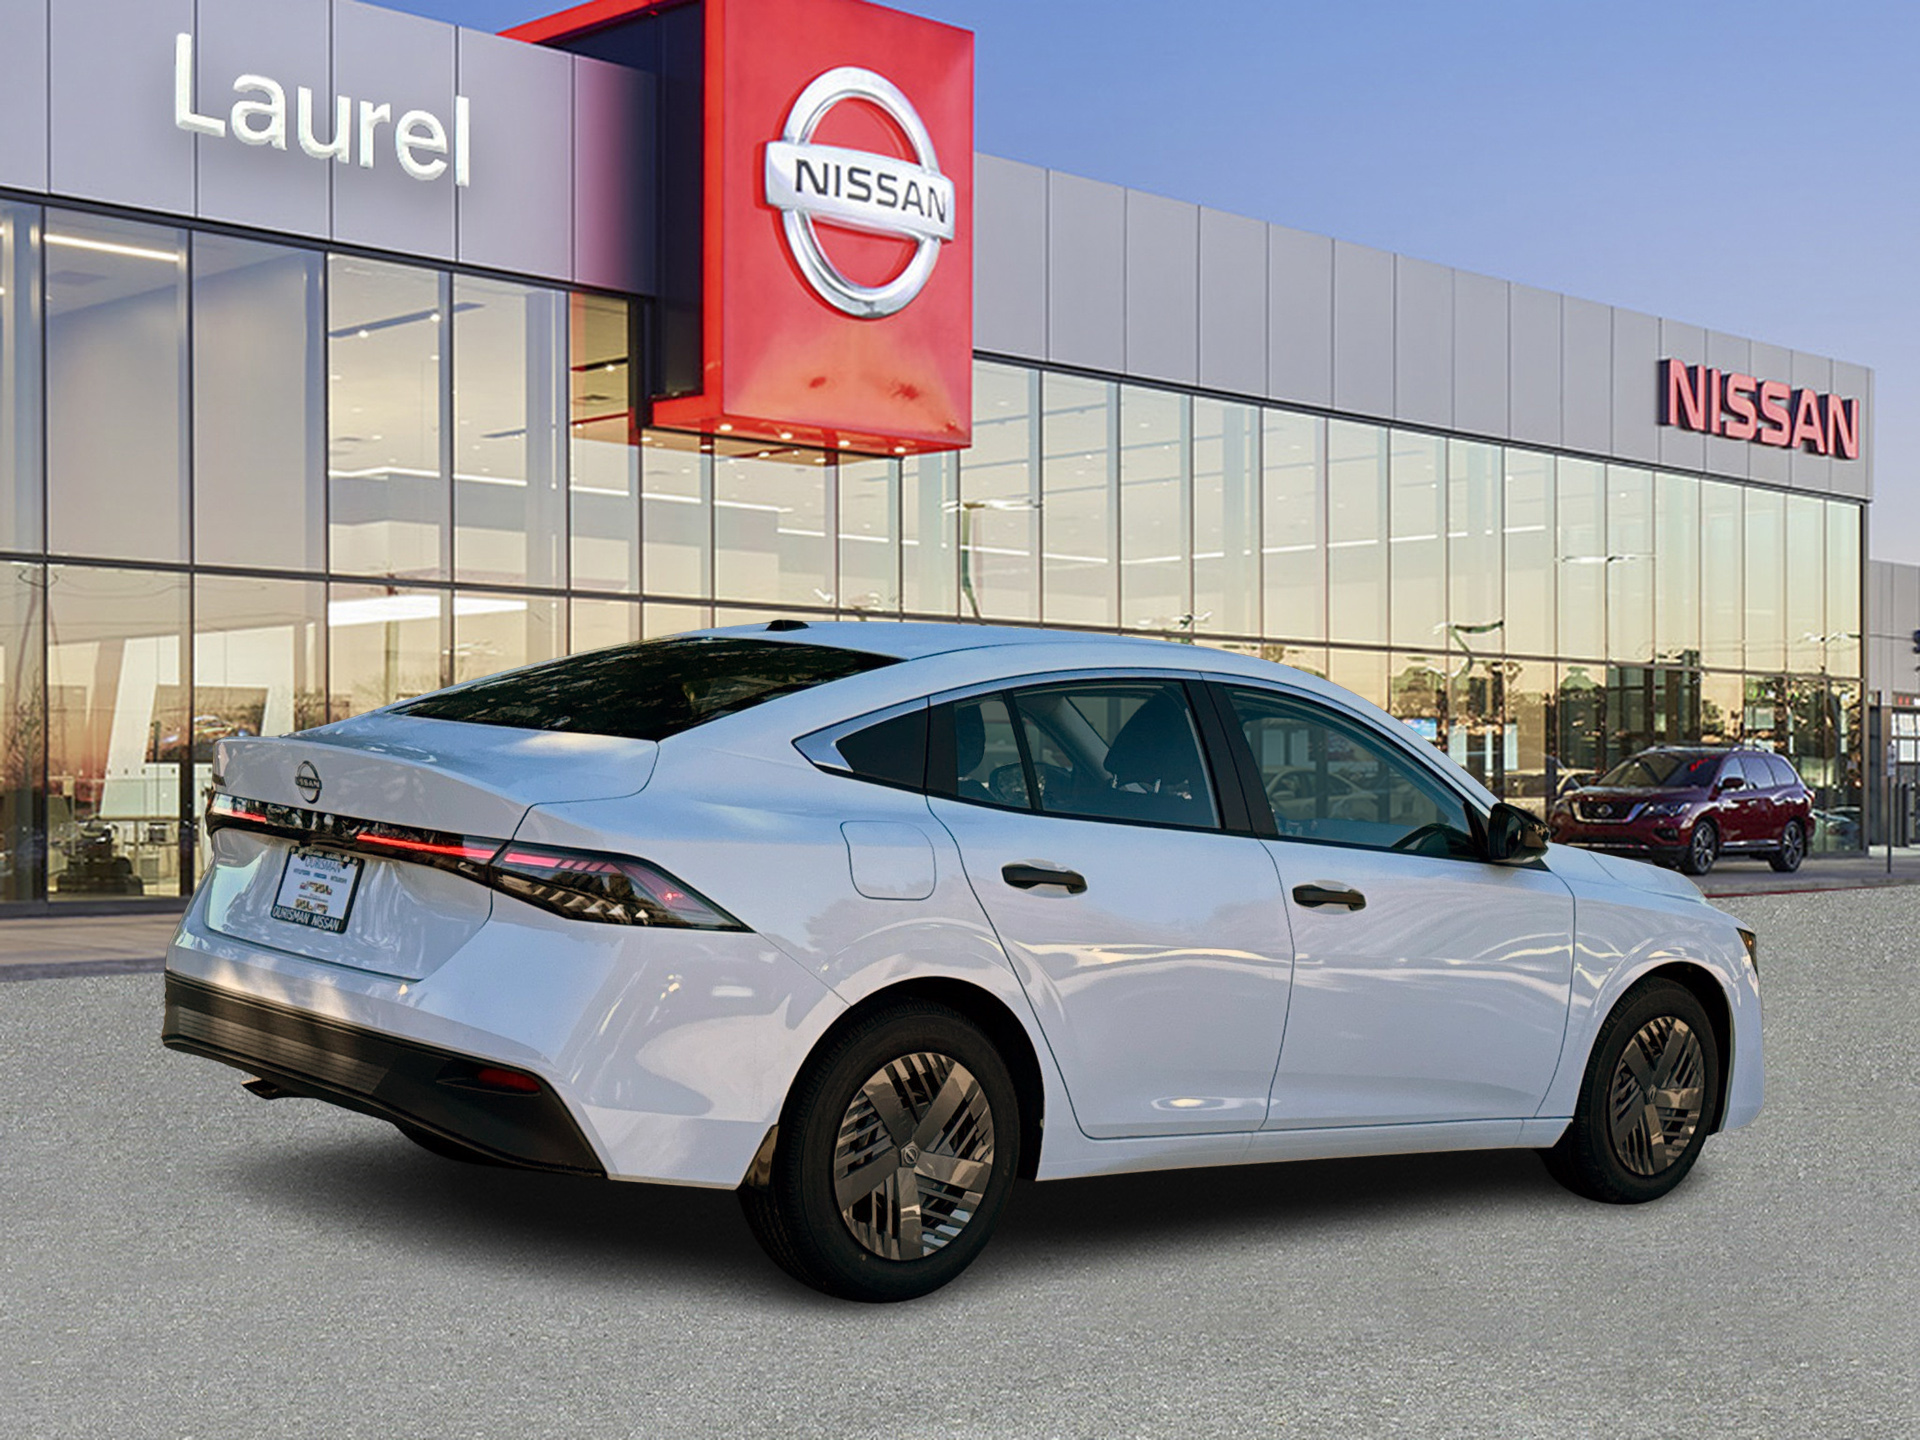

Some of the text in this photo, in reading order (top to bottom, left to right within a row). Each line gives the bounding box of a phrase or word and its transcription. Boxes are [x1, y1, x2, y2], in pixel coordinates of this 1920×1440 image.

[175, 33, 470, 187] Laurel
[795, 158, 947, 224] NISSAN
[1658, 358, 1860, 460] NISSAN
[272, 906, 340, 931] OURISMAN NISSAN
